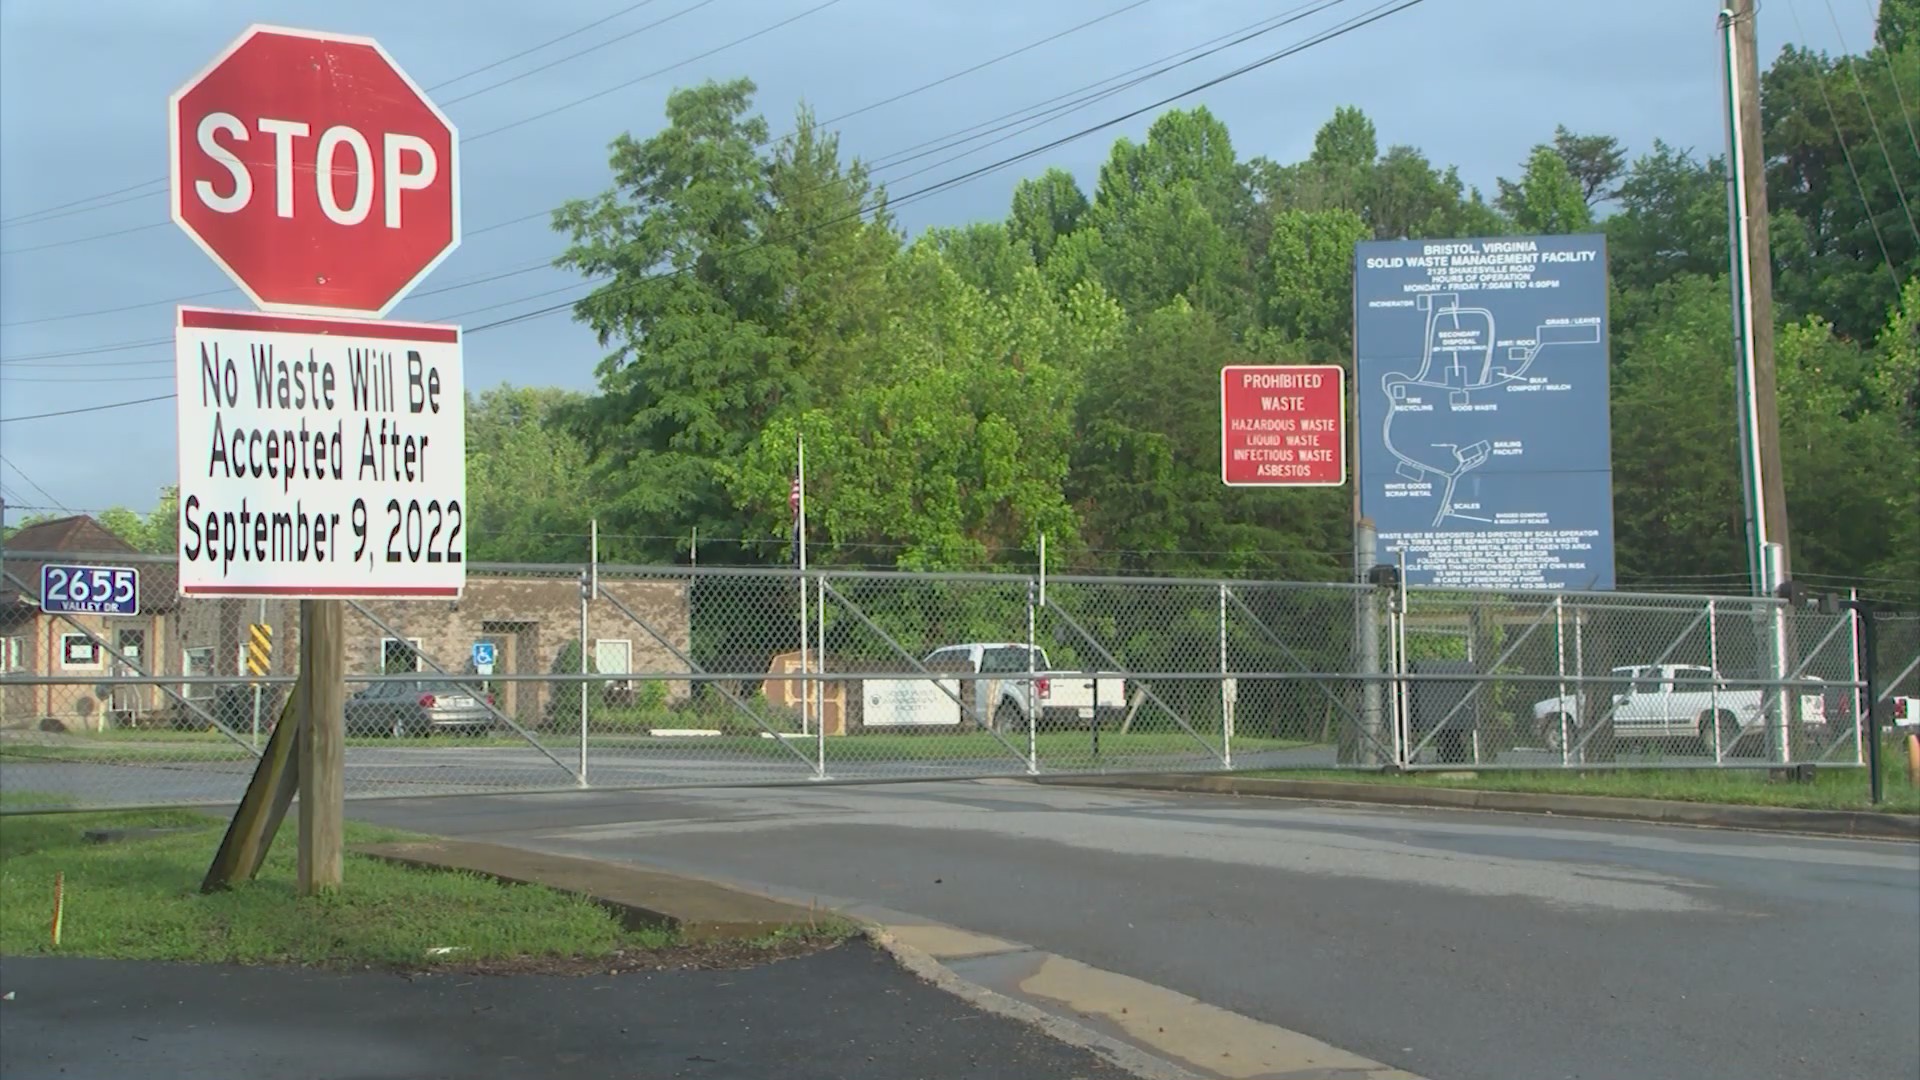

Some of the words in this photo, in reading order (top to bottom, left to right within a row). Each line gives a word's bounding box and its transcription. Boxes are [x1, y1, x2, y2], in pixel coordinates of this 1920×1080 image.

[195, 112, 438, 228] STOP
[1424, 244, 1480, 255] BRISTOL,
[1482, 241, 1538, 253] VIRGINIA
[1366, 257, 1404, 269] SOLID
[1405, 256, 1449, 267] WASTE
[1451, 253, 1539, 266] MANAGEMENT
[1541, 251, 1597, 263] FACILITY
[1448, 265, 1508, 275] SHAKESVILLE
[1509, 264, 1535, 272] ROAD
[1432, 275, 1463, 283] HOURS
[1479, 273, 1531, 281] OPERATION
[1403, 284, 1441, 292] MONDAY
[1448, 283, 1479, 291] FRIDAY
[1514, 281, 1527, 289] TO
[201, 341, 238, 408] No
[251, 343, 335, 410] Waste
[348, 347, 394, 412] Will
[407, 350, 440, 414] Be
[1243, 374, 1322, 388] PROHIBITED
[1261, 397, 1305, 411] WASTE
[1231, 419, 1295, 431] HAZARDOUS
[1300, 419, 1335, 431] WASTE
[1246, 435, 1281, 446] LIQUID
[1286, 435, 1320, 446] WASTE
[209, 412, 343, 494] Accepted
[359, 417, 428, 482] After
[1233, 449, 1294, 461] INFECTIOUS
[1298, 449, 1333, 462] WASTE
[1257, 464, 1311, 476] ASBESTOS
[184, 495, 340, 578] September
[352, 498, 374, 573] 9,
[386, 499, 462, 563] 2022
[47, 569, 134, 603] 2655
[61, 601, 102, 611] VALLEY
[104, 603, 119, 612] DR
